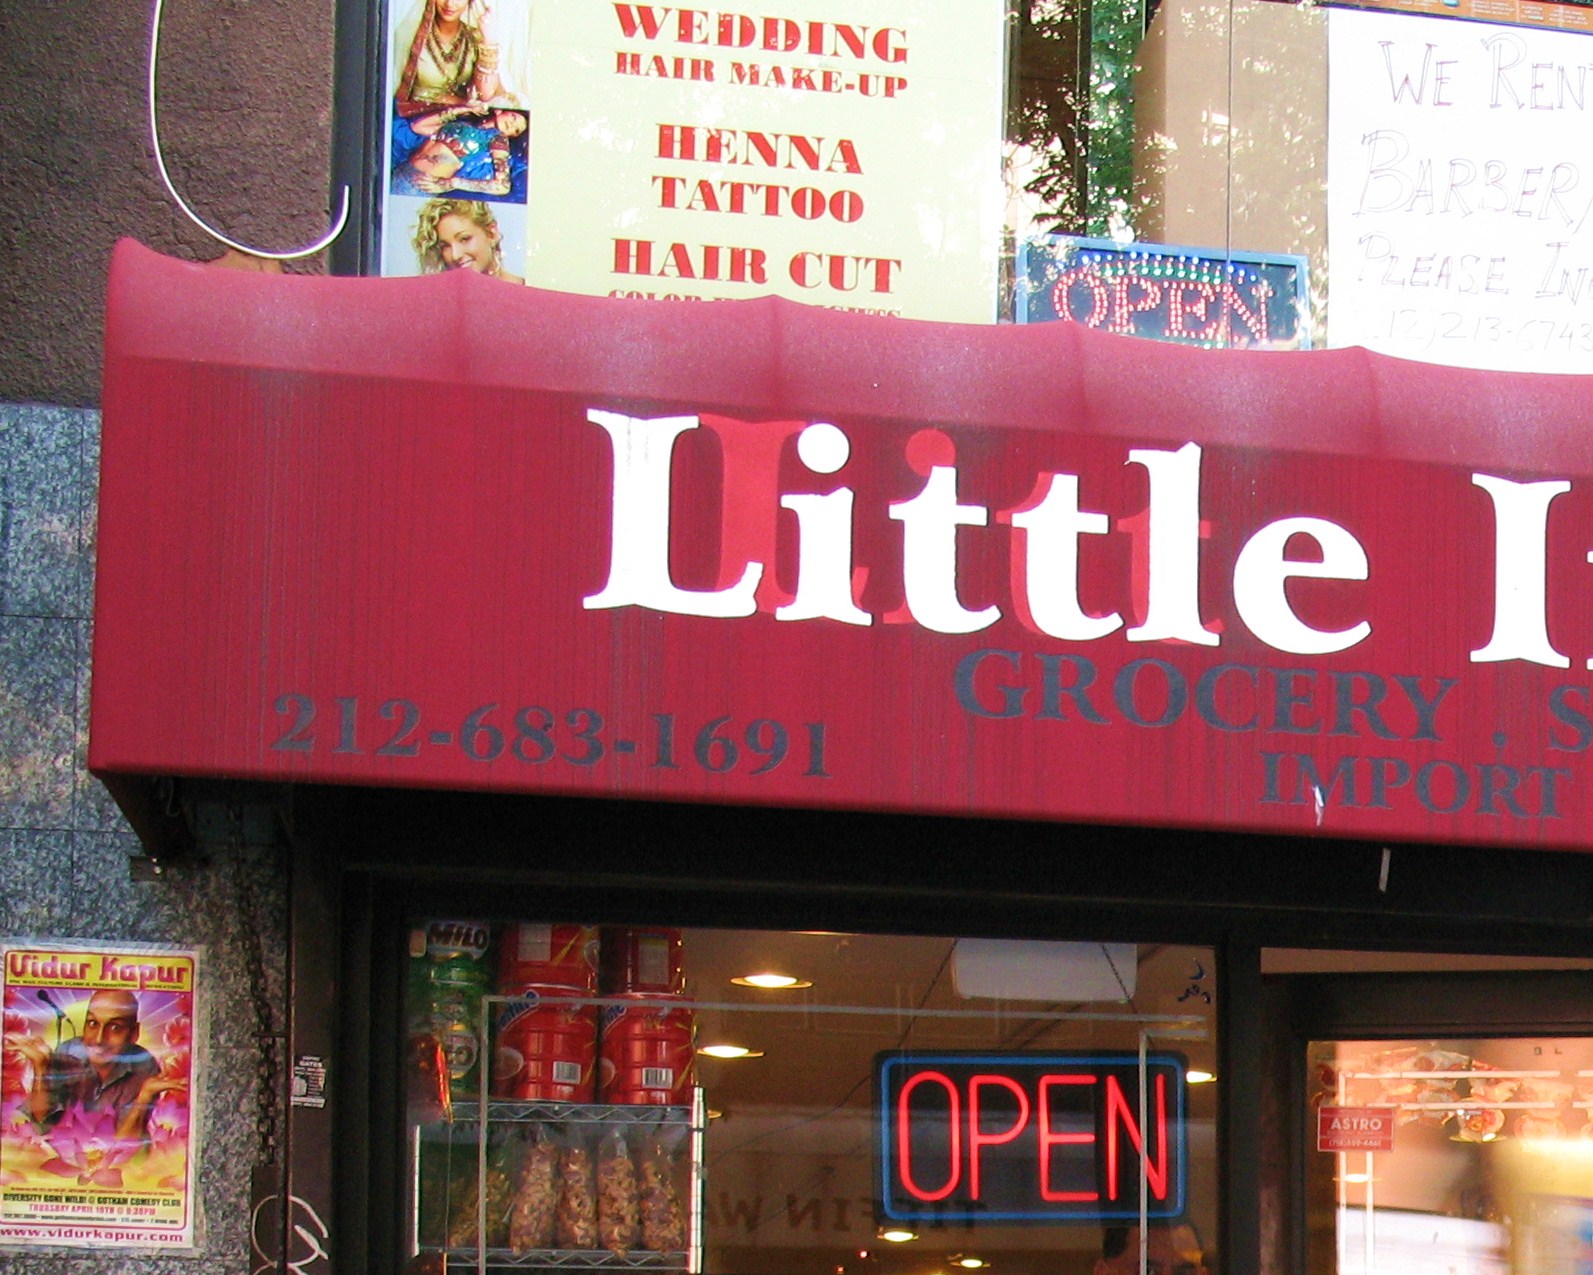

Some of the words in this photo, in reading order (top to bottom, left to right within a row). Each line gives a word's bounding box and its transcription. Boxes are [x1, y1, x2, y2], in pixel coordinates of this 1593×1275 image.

[614, 2, 909, 65] WEDDING
[614, 51, 716, 84] HAIR
[729, 61, 909, 100] MAKE-UP
[1377, 39, 1459, 108] WE
[654, 123, 864, 175] HENNA
[651, 175, 865, 224] TATTOO
[609, 238, 769, 286] HAIR
[789, 251, 902, 294] CUT
[1358, 231, 1511, 297] PLEASE
[1053, 270, 1275, 346] OPEN
[583, 408, 1372, 655] Little
[953, 648, 1461, 745] GROCERY
[270, 693, 834, 779] 212-683-1691
[1260, 751, 1573, 819] IMPORT
[9, 954, 92, 980] Vidur
[100, 956, 189, 990] Kapur
[897, 1070, 1167, 1202] OPEN
[1330, 1118, 1382, 1131] ASTRO
[0, 1228, 183, 1242] www.vidurkapur.com
